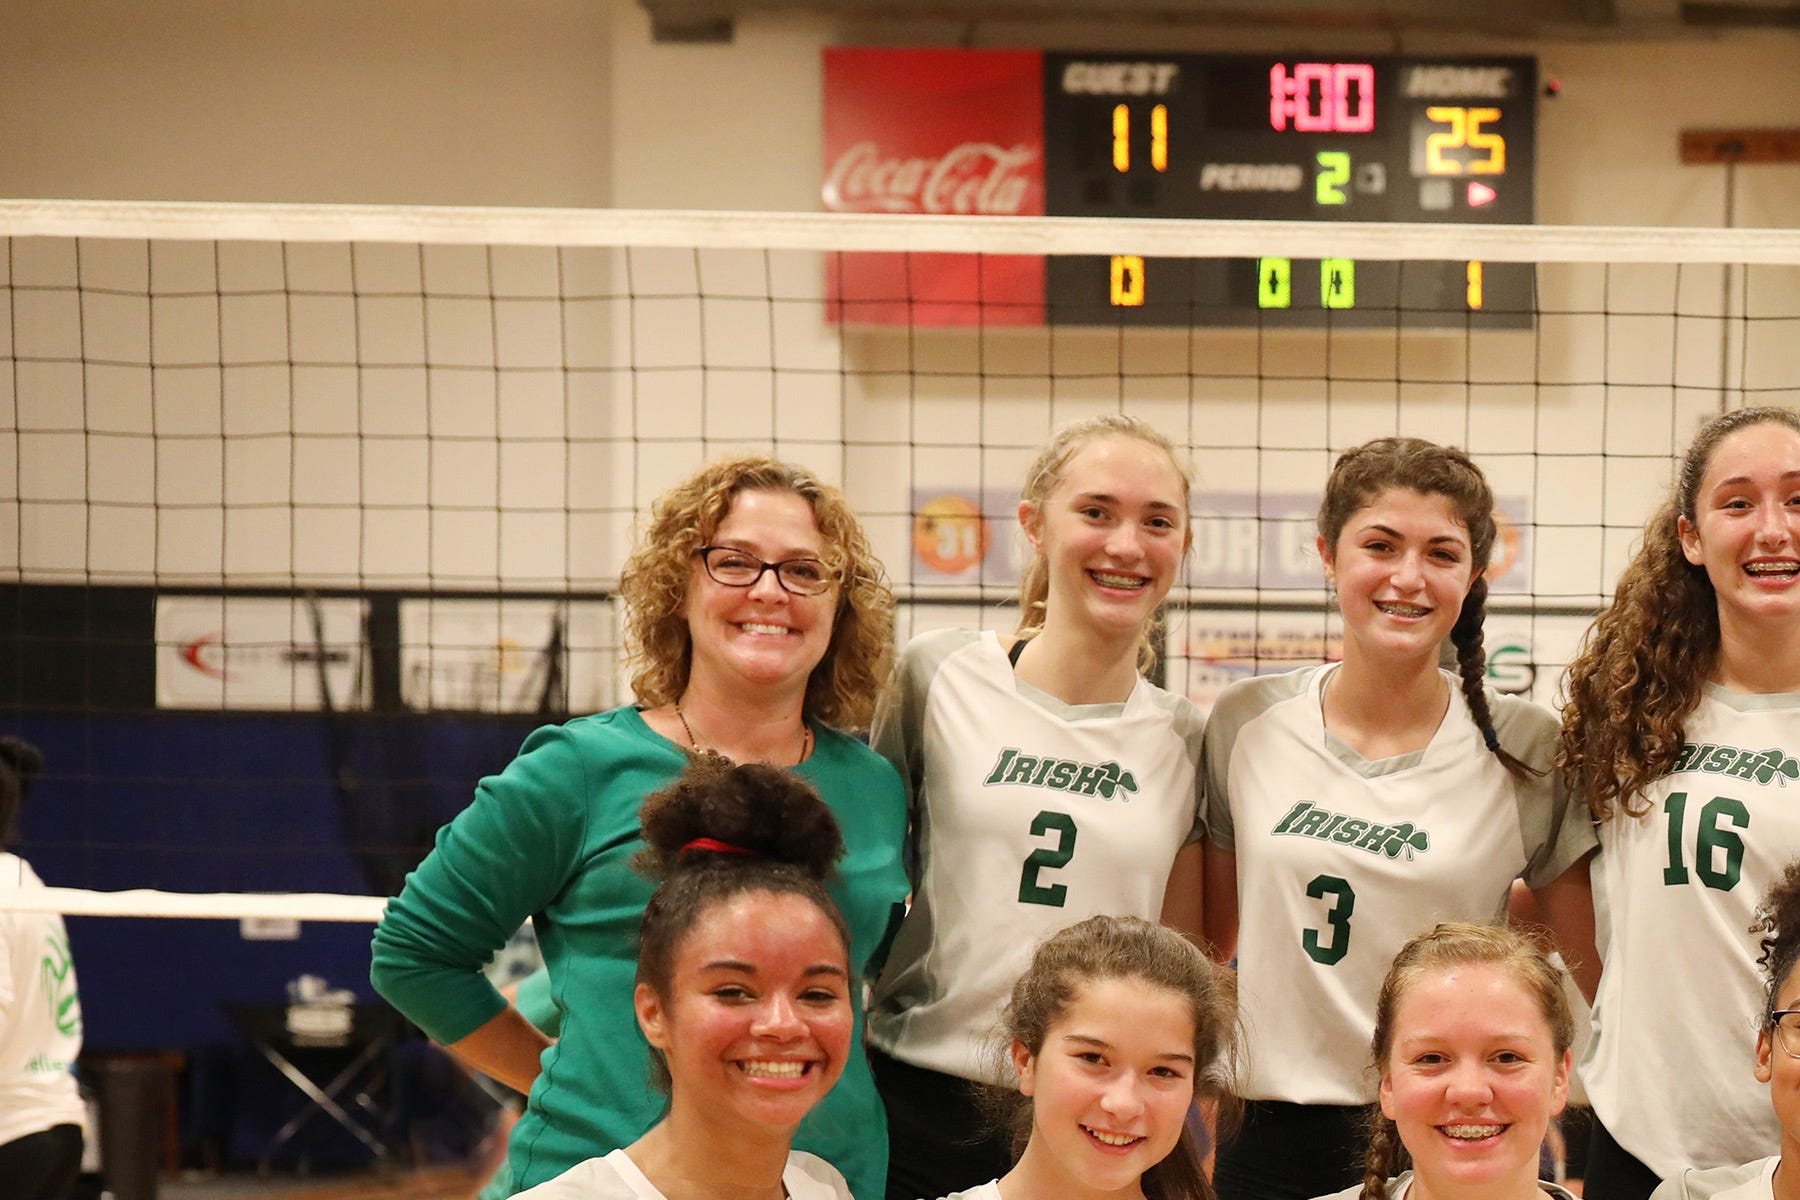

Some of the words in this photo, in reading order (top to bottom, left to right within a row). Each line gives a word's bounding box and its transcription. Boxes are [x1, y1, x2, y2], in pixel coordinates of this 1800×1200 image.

[1062, 62, 1178, 94] GUEST
[1270, 63, 1375, 132] 1:00
[1407, 66, 1512, 98] HOME
[1112, 104, 1168, 172] 11
[1426, 106, 1506, 174] 25
[1201, 163, 1302, 191] PERIOD
[1315, 152, 1350, 204] 2
[1110, 257, 1145, 306] 0
[1467, 260, 1482, 309] 1
[984, 747, 1108, 799] IRISH
[1648, 743, 1767, 784] RISH
[1271, 801, 1396, 857] IRISH
[1662, 792, 1751, 892] 16
[1018, 811, 1077, 907] 2
[1302, 874, 1356, 966] 3
